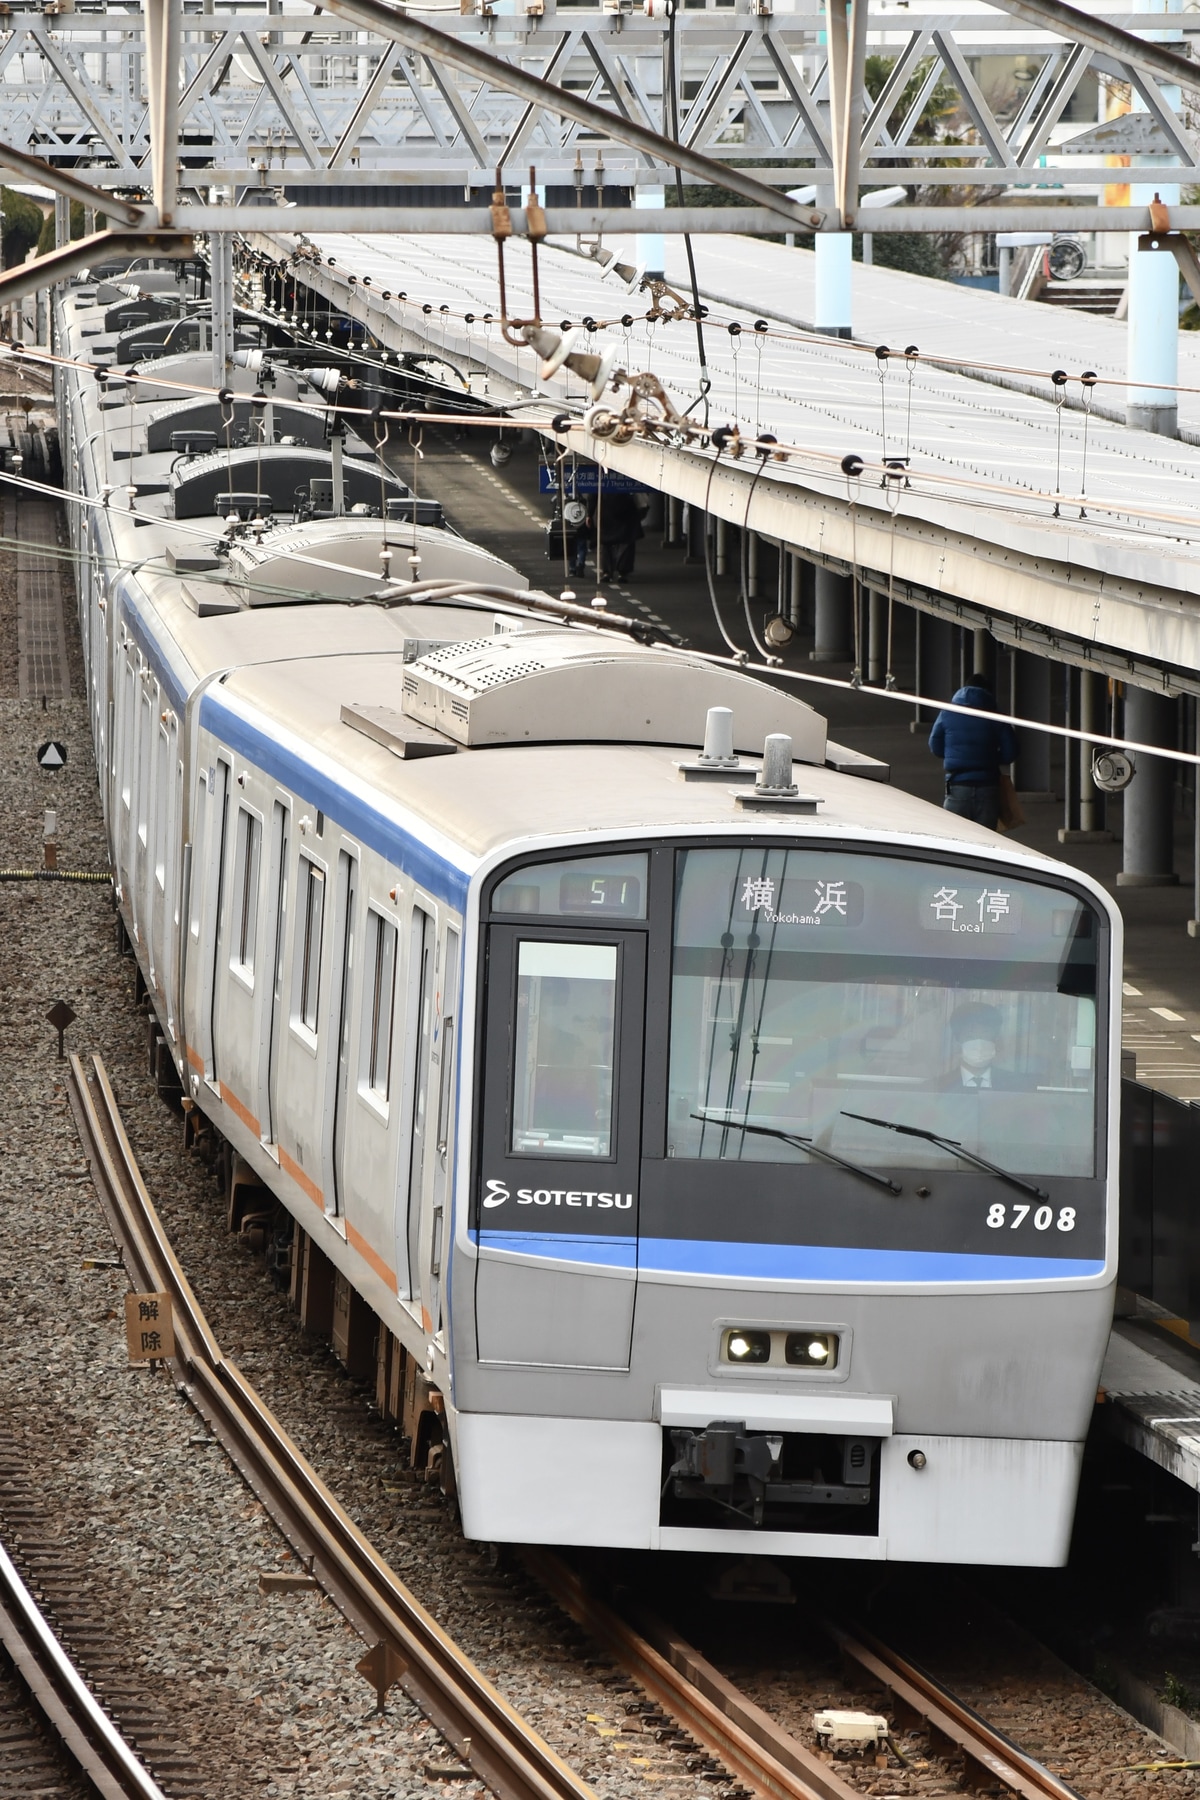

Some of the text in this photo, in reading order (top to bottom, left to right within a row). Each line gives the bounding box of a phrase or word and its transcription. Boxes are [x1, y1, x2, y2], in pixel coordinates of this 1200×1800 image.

[590, 879, 627, 905] 51
[741, 877, 847, 915] 横浜
[930, 886, 1010, 923] 各停
[764, 911, 821, 925] Yokohama
[951, 920, 985, 933] Local
[516, 1188, 633, 1210] SOTETSU
[986, 1203, 1077, 1232] 8708
[137, 1300, 162, 1353] 解除
